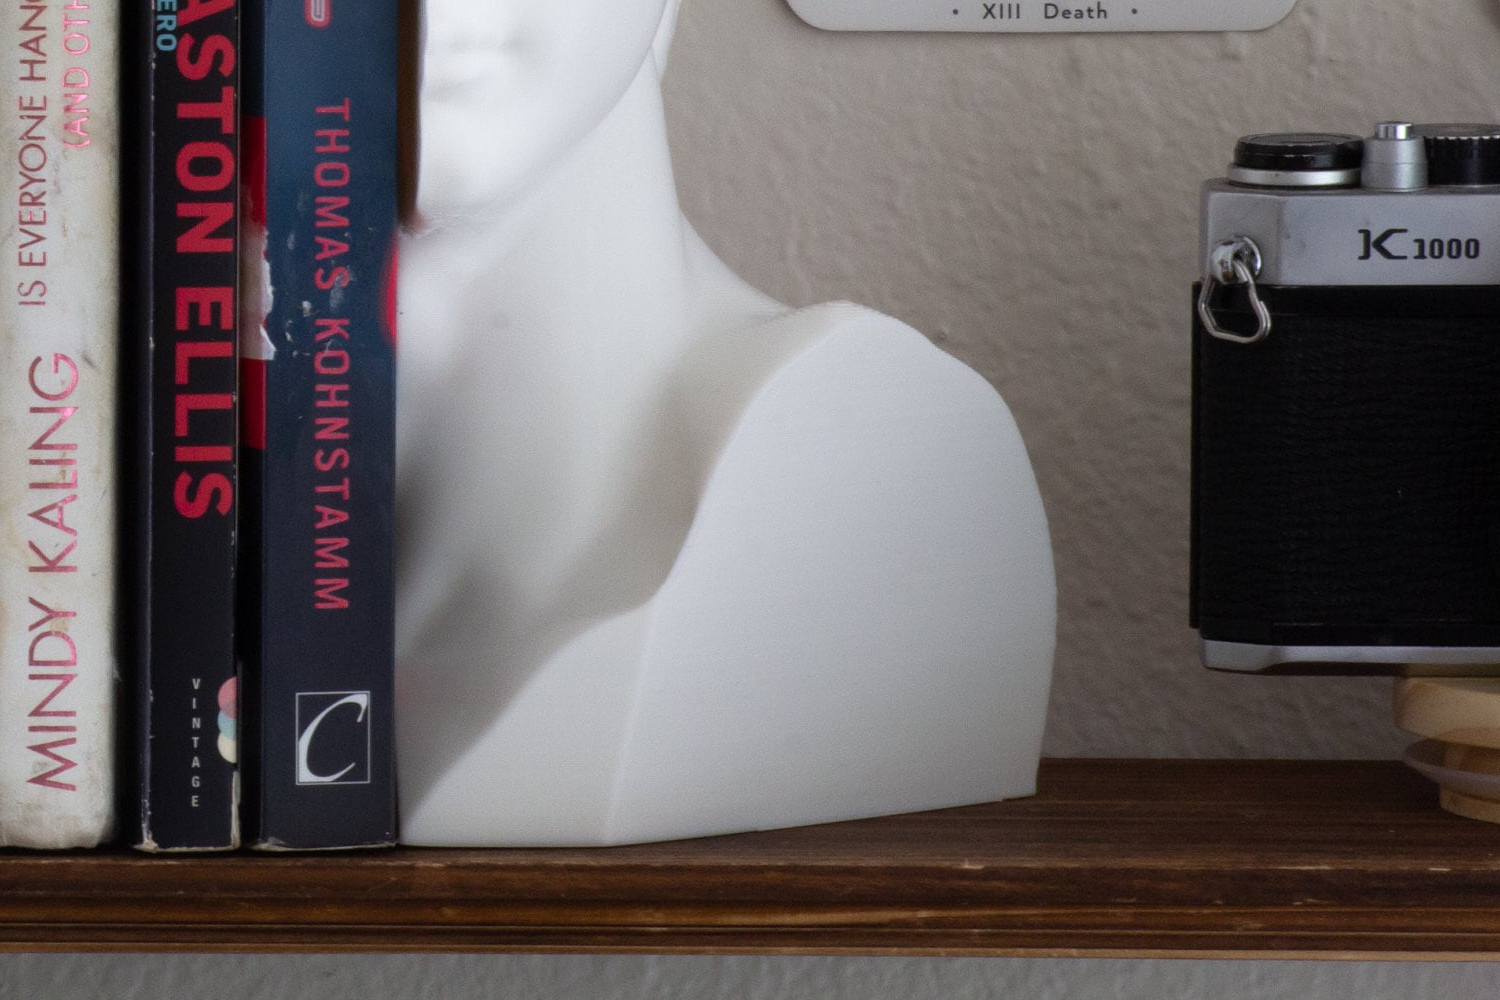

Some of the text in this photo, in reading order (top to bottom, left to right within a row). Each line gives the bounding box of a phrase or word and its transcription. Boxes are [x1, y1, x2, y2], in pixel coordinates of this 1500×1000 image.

[981, 0, 1108, 20] XIII Death
[61, 66, 92, 150] (AND
[17, 94, 48, 268] EVERYONE
[1357, 228, 1481, 261] K1000
[17, 278, 48, 307] IS
[312, 97, 352, 610] THOMAS KOHNSTAMM
[173, 285, 235, 519] ELLIS
[26, 351, 80, 793] MINDY KALING
[190, 677, 202, 808] VINTAGE
